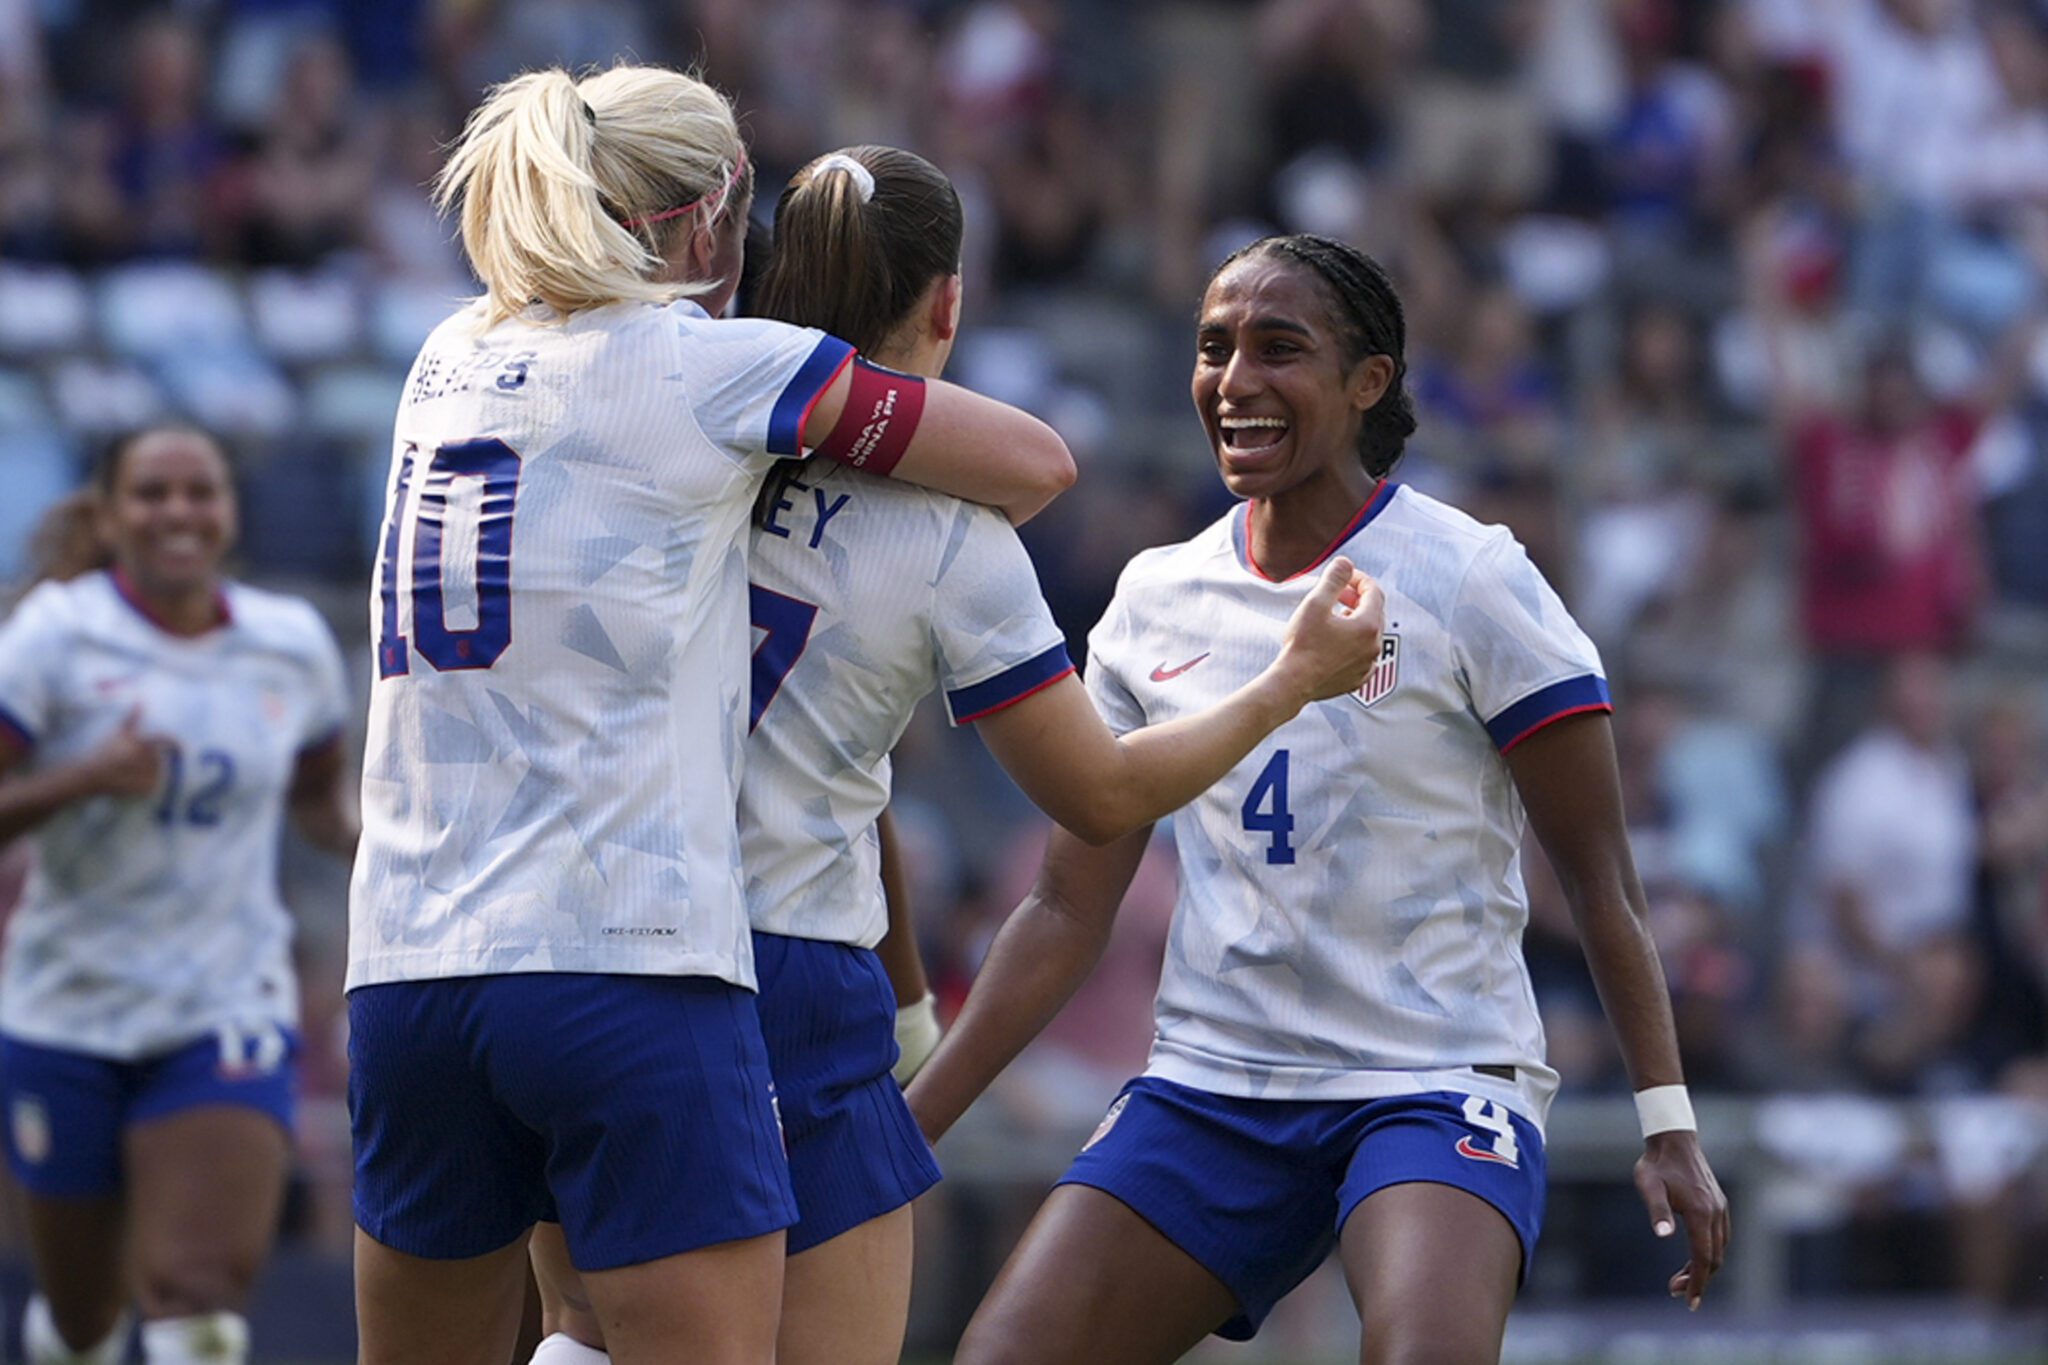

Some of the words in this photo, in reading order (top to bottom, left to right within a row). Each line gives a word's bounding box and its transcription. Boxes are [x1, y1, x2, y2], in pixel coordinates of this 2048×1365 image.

[846, 423, 875, 458] USA
[853, 419, 889, 467] CHINA
[883, 388, 897, 416] PR
[379, 437, 521, 681] 10
[154, 747, 236, 828] 12
[1241, 749, 1295, 864] 4
[1461, 1095, 1518, 1163] 4
